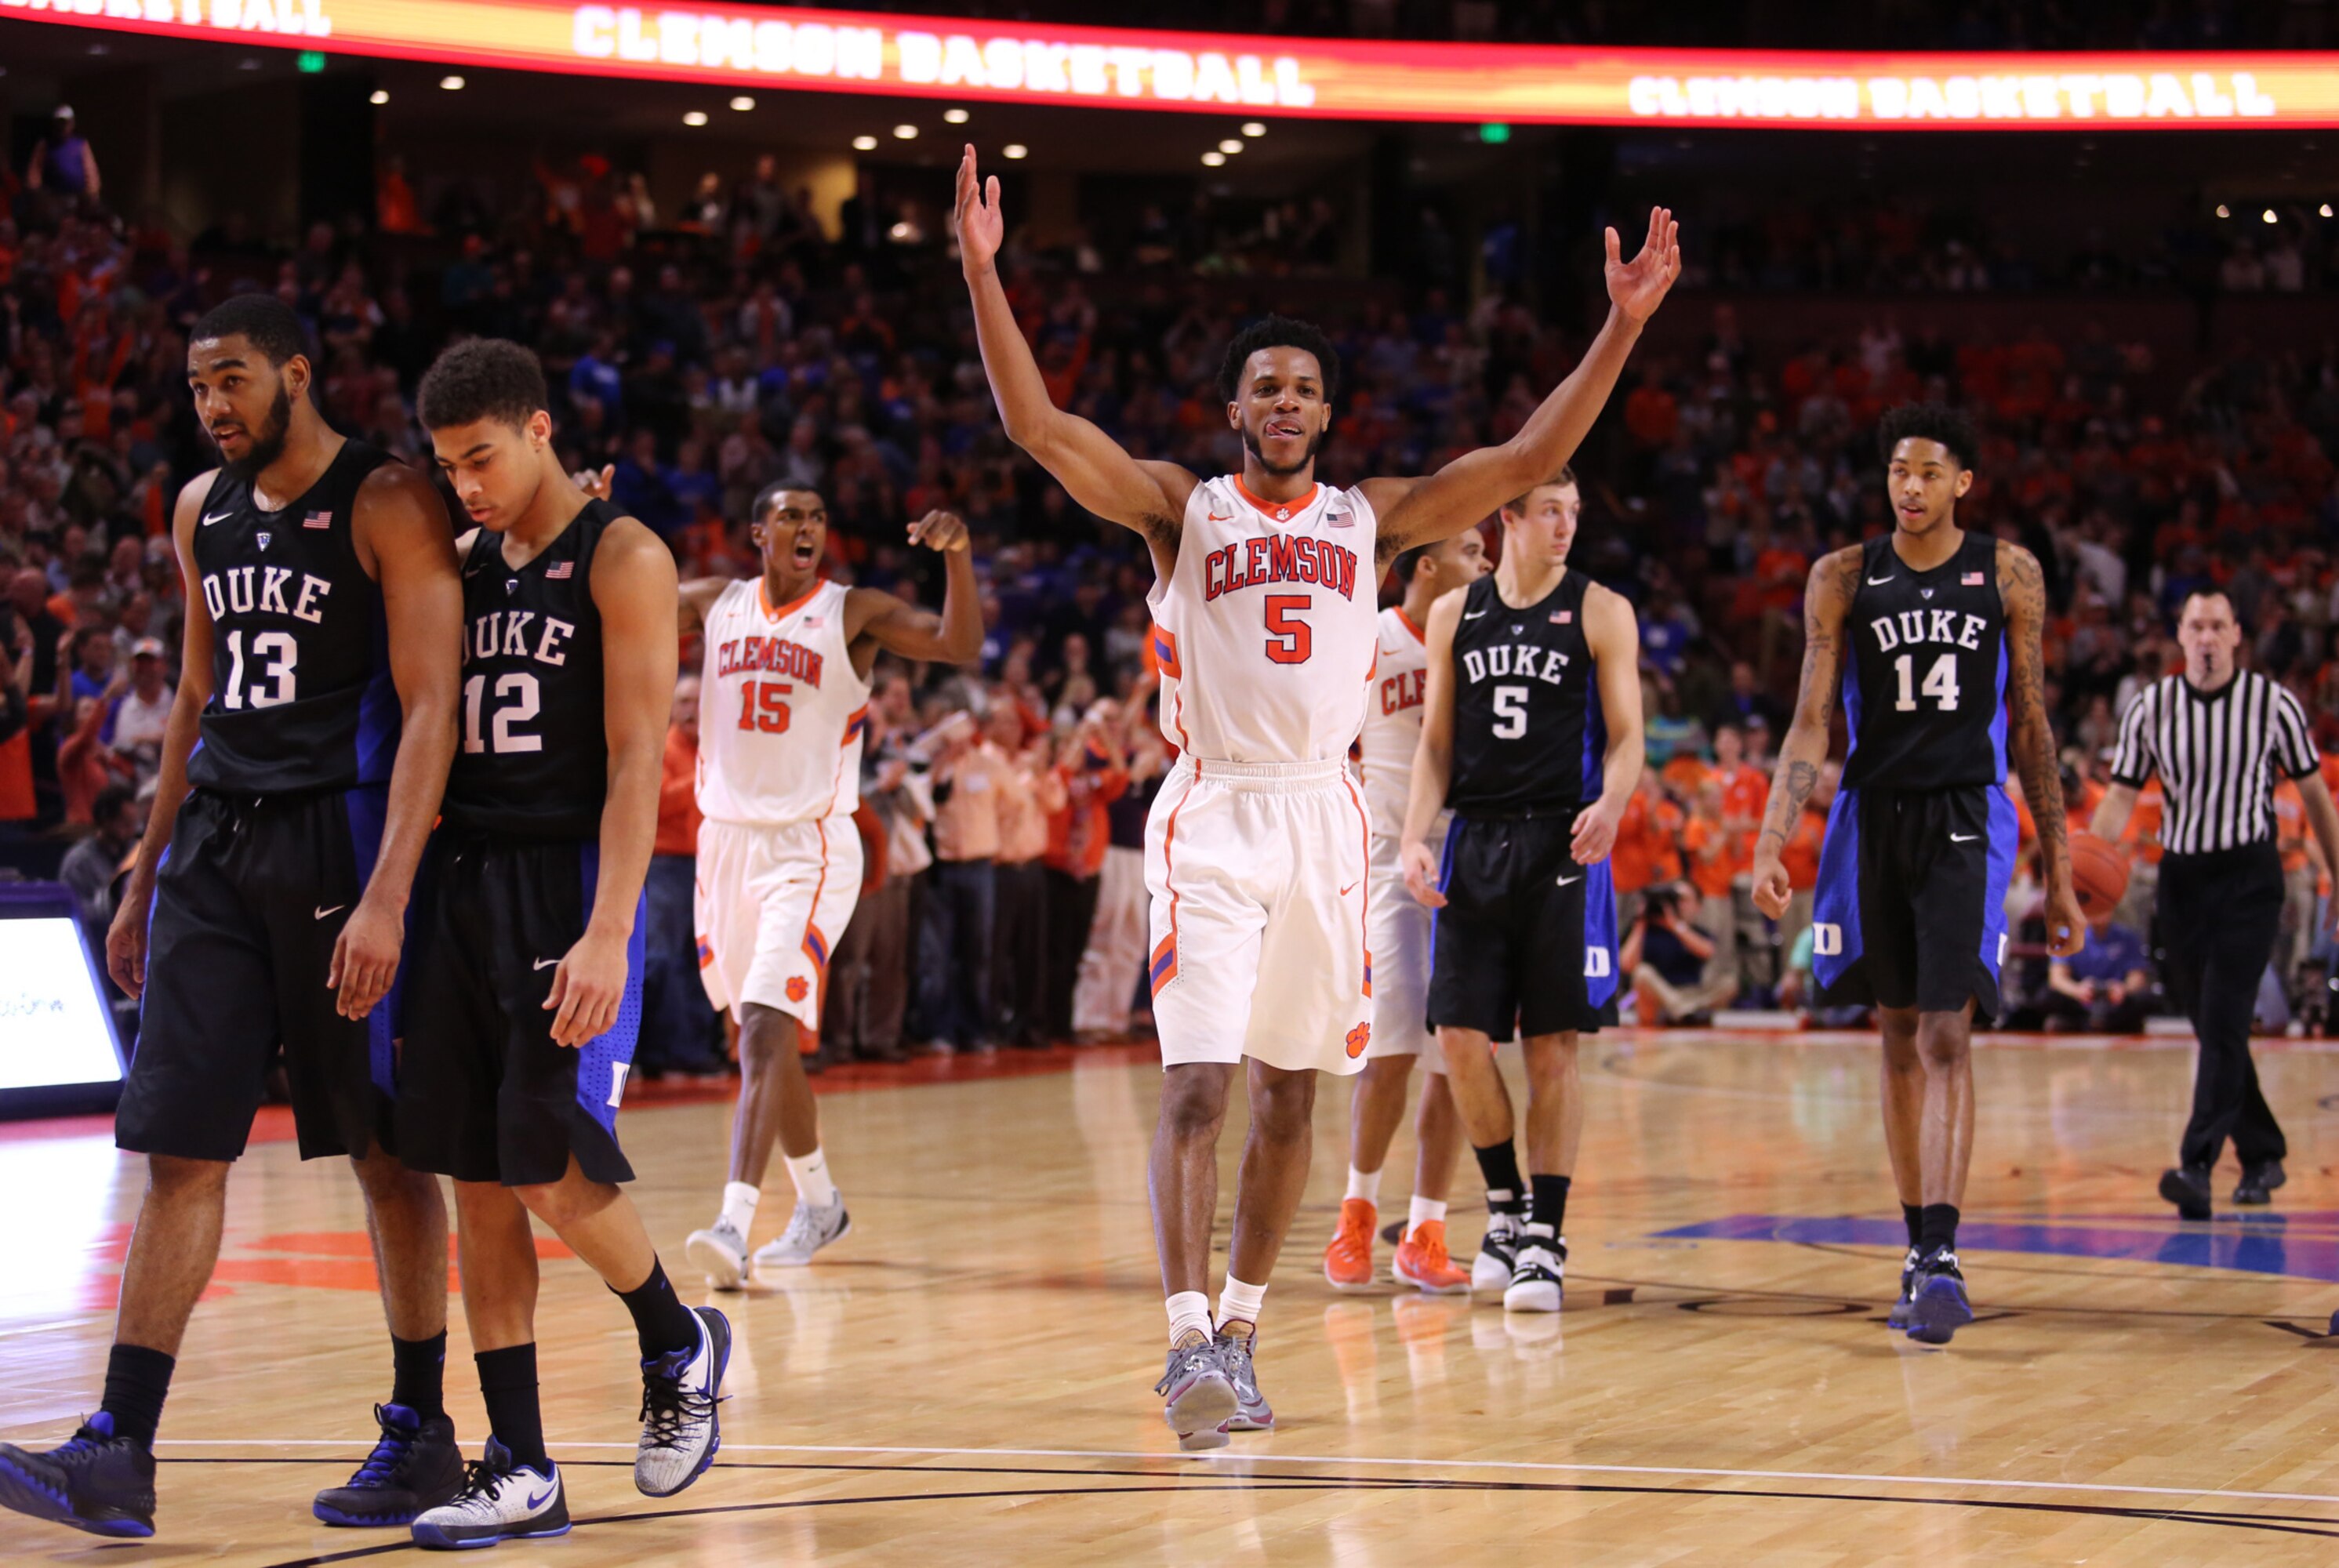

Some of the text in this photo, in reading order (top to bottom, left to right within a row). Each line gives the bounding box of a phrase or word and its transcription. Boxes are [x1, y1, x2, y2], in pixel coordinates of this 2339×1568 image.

[573, 5, 1315, 107] CLEMSON BASKETBALL
[1868, 74, 2275, 118] BASKETBALL
[202, 565, 332, 624] DUKE
[1205, 533, 1357, 602] CLEMSON
[1265, 594, 1312, 665] 5
[1870, 608, 1987, 652] DUKE
[224, 630, 299, 710] 13
[718, 636, 823, 690] CLEMSON
[1463, 644, 1570, 685] DUKE
[1894, 653, 1960, 712] 14
[464, 672, 543, 753] 12
[738, 680, 793, 734] 15
[1491, 685, 1529, 739] 5
